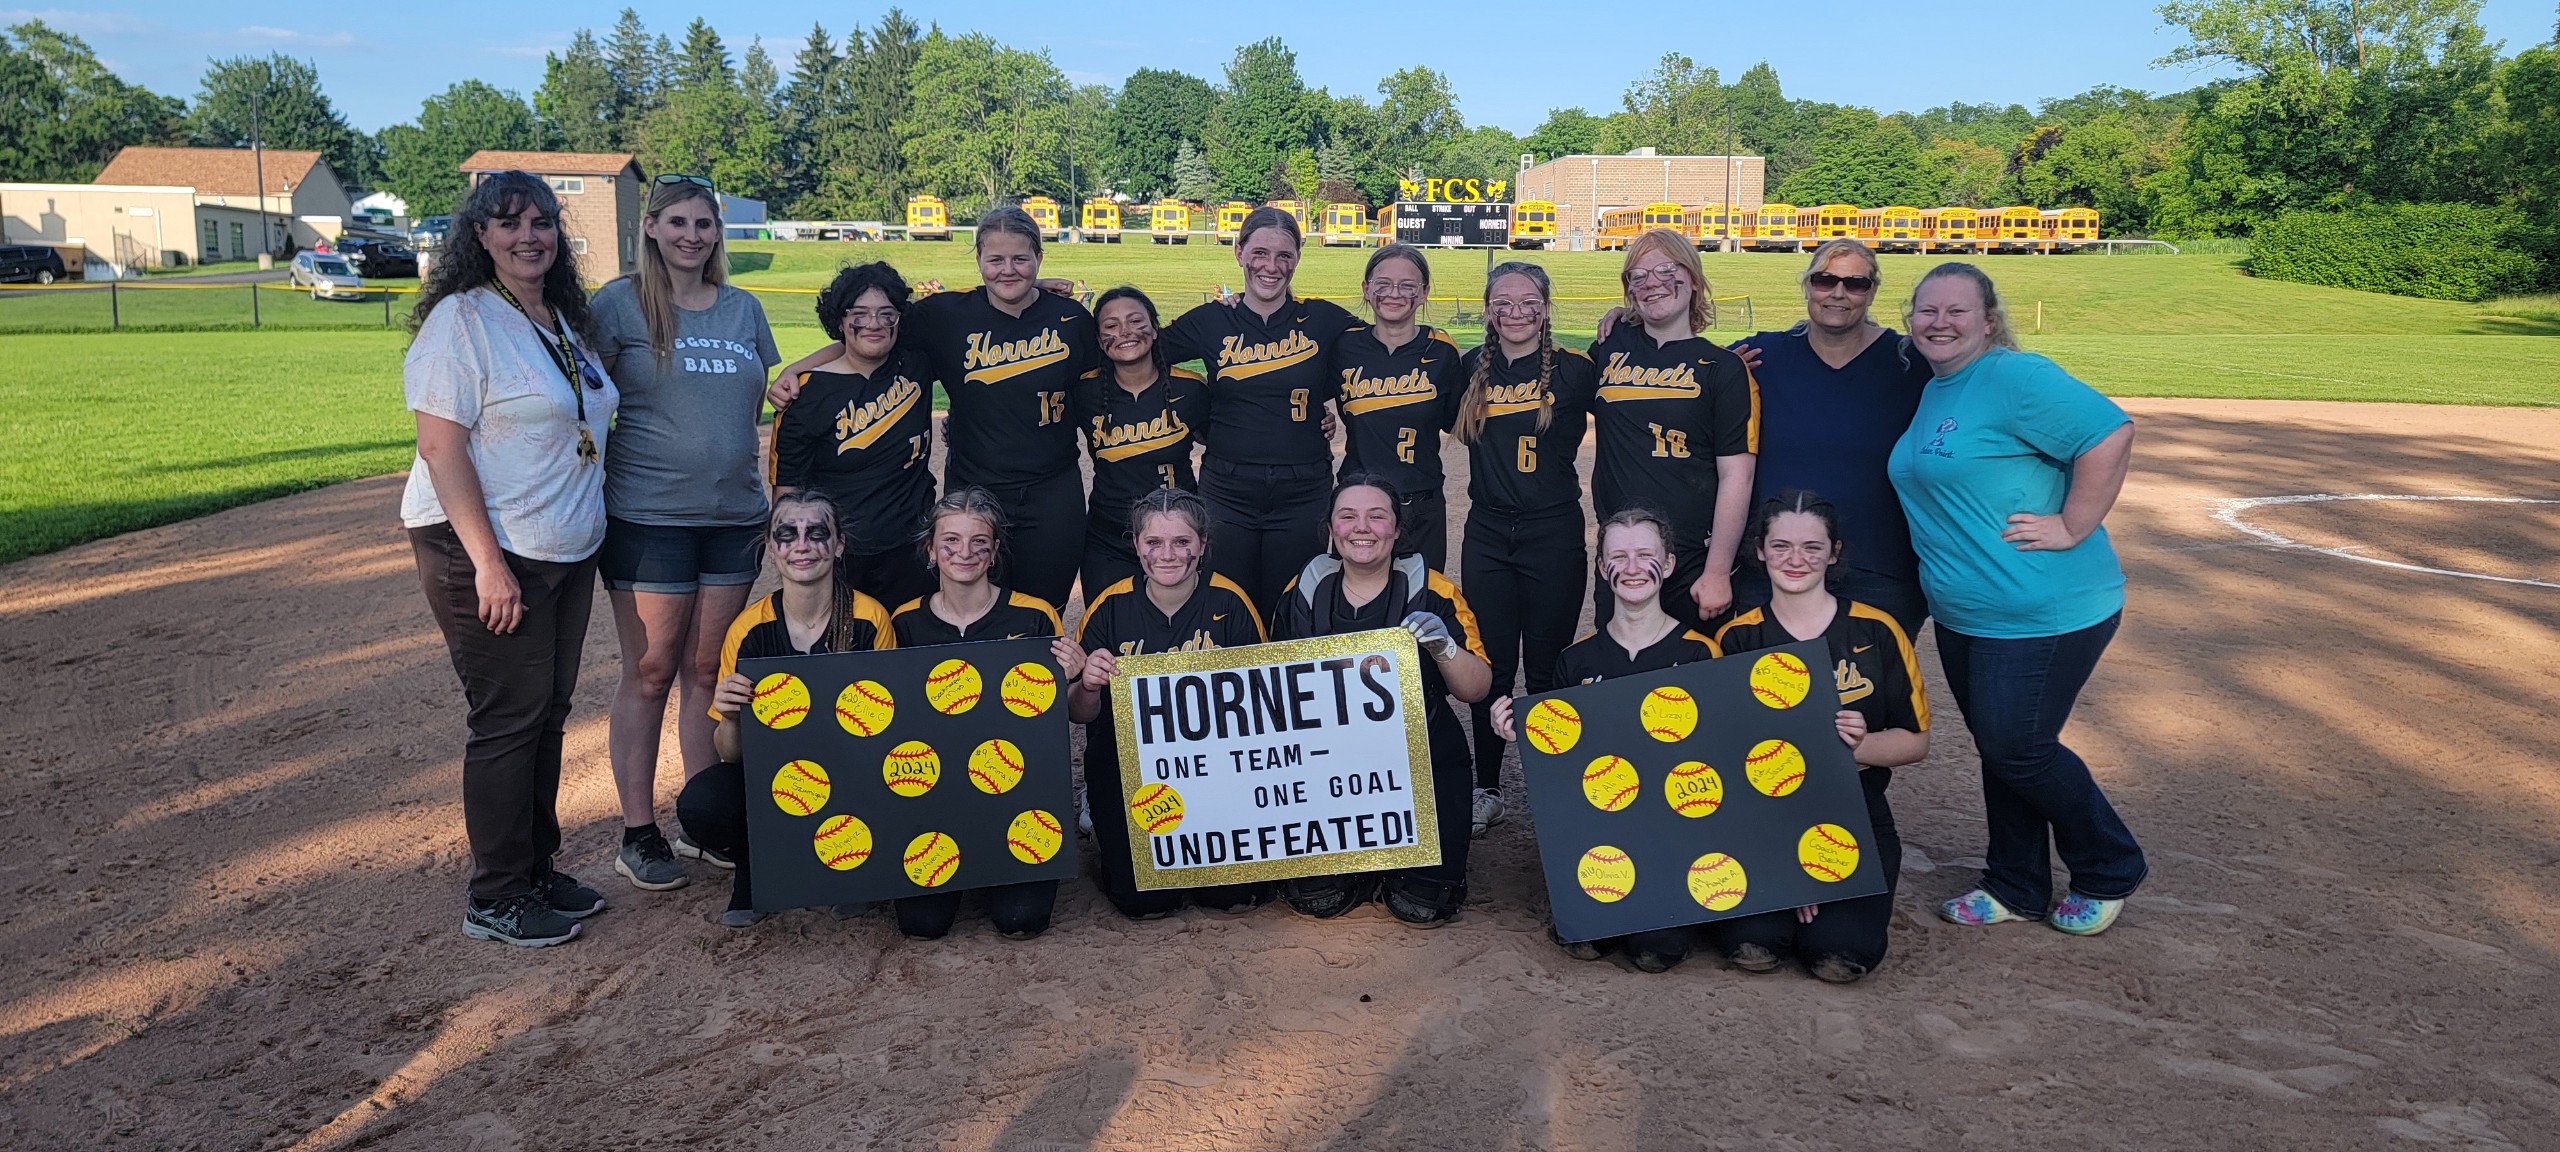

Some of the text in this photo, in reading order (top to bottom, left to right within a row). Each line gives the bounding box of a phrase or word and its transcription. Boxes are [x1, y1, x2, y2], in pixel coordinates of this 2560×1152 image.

[1425, 178, 1480, 203] FCS
[1432, 205, 1452, 213] STRIKE
[1463, 205, 1476, 213] OUT
[1397, 218, 1507, 230] GUEST HORNETS
[1440, 236, 1464, 245] INNING
[686, 336, 720, 349] GOT
[723, 339, 754, 361] YOU
[963, 327, 1063, 370] Hornets
[1217, 329, 1313, 367] Hornets
[683, 357, 738, 374] BABE
[1599, 351, 1696, 387] Hornets
[1340, 365, 1433, 402] Hornets
[835, 375, 914, 440] Hornets
[1290, 388, 1310, 422] 9
[1397, 427, 1417, 464] 2
[1517, 435, 1537, 473] 6
[1158, 464, 1175, 490] 3
[1005, 678, 1018, 688] #6
[1019, 685, 1036, 697] Ava
[1136, 654, 1396, 745] HORNETS
[770, 696, 793, 710] Olivia
[841, 692, 858, 704] #20
[854, 701, 876, 718] Ellie
[1533, 709, 1557, 724] Coach
[782, 769, 805, 784] Coach
[890, 761, 936, 777] 2024
[975, 748, 988, 759] #9
[984, 757, 1006, 780] Emma
[1155, 754, 1209, 780] ONE
[1254, 769, 1403, 809] ONE GOAL
[1675, 776, 1718, 799] 2024
[1142, 795, 1182, 823] 2024
[1014, 819, 1028, 830] #3
[1025, 827, 1042, 844] Ellie
[1153, 810, 1414, 868] UNDEFEATED!
[1809, 838, 1838, 855] Coach
[1595, 868, 1620, 880] Olivia
